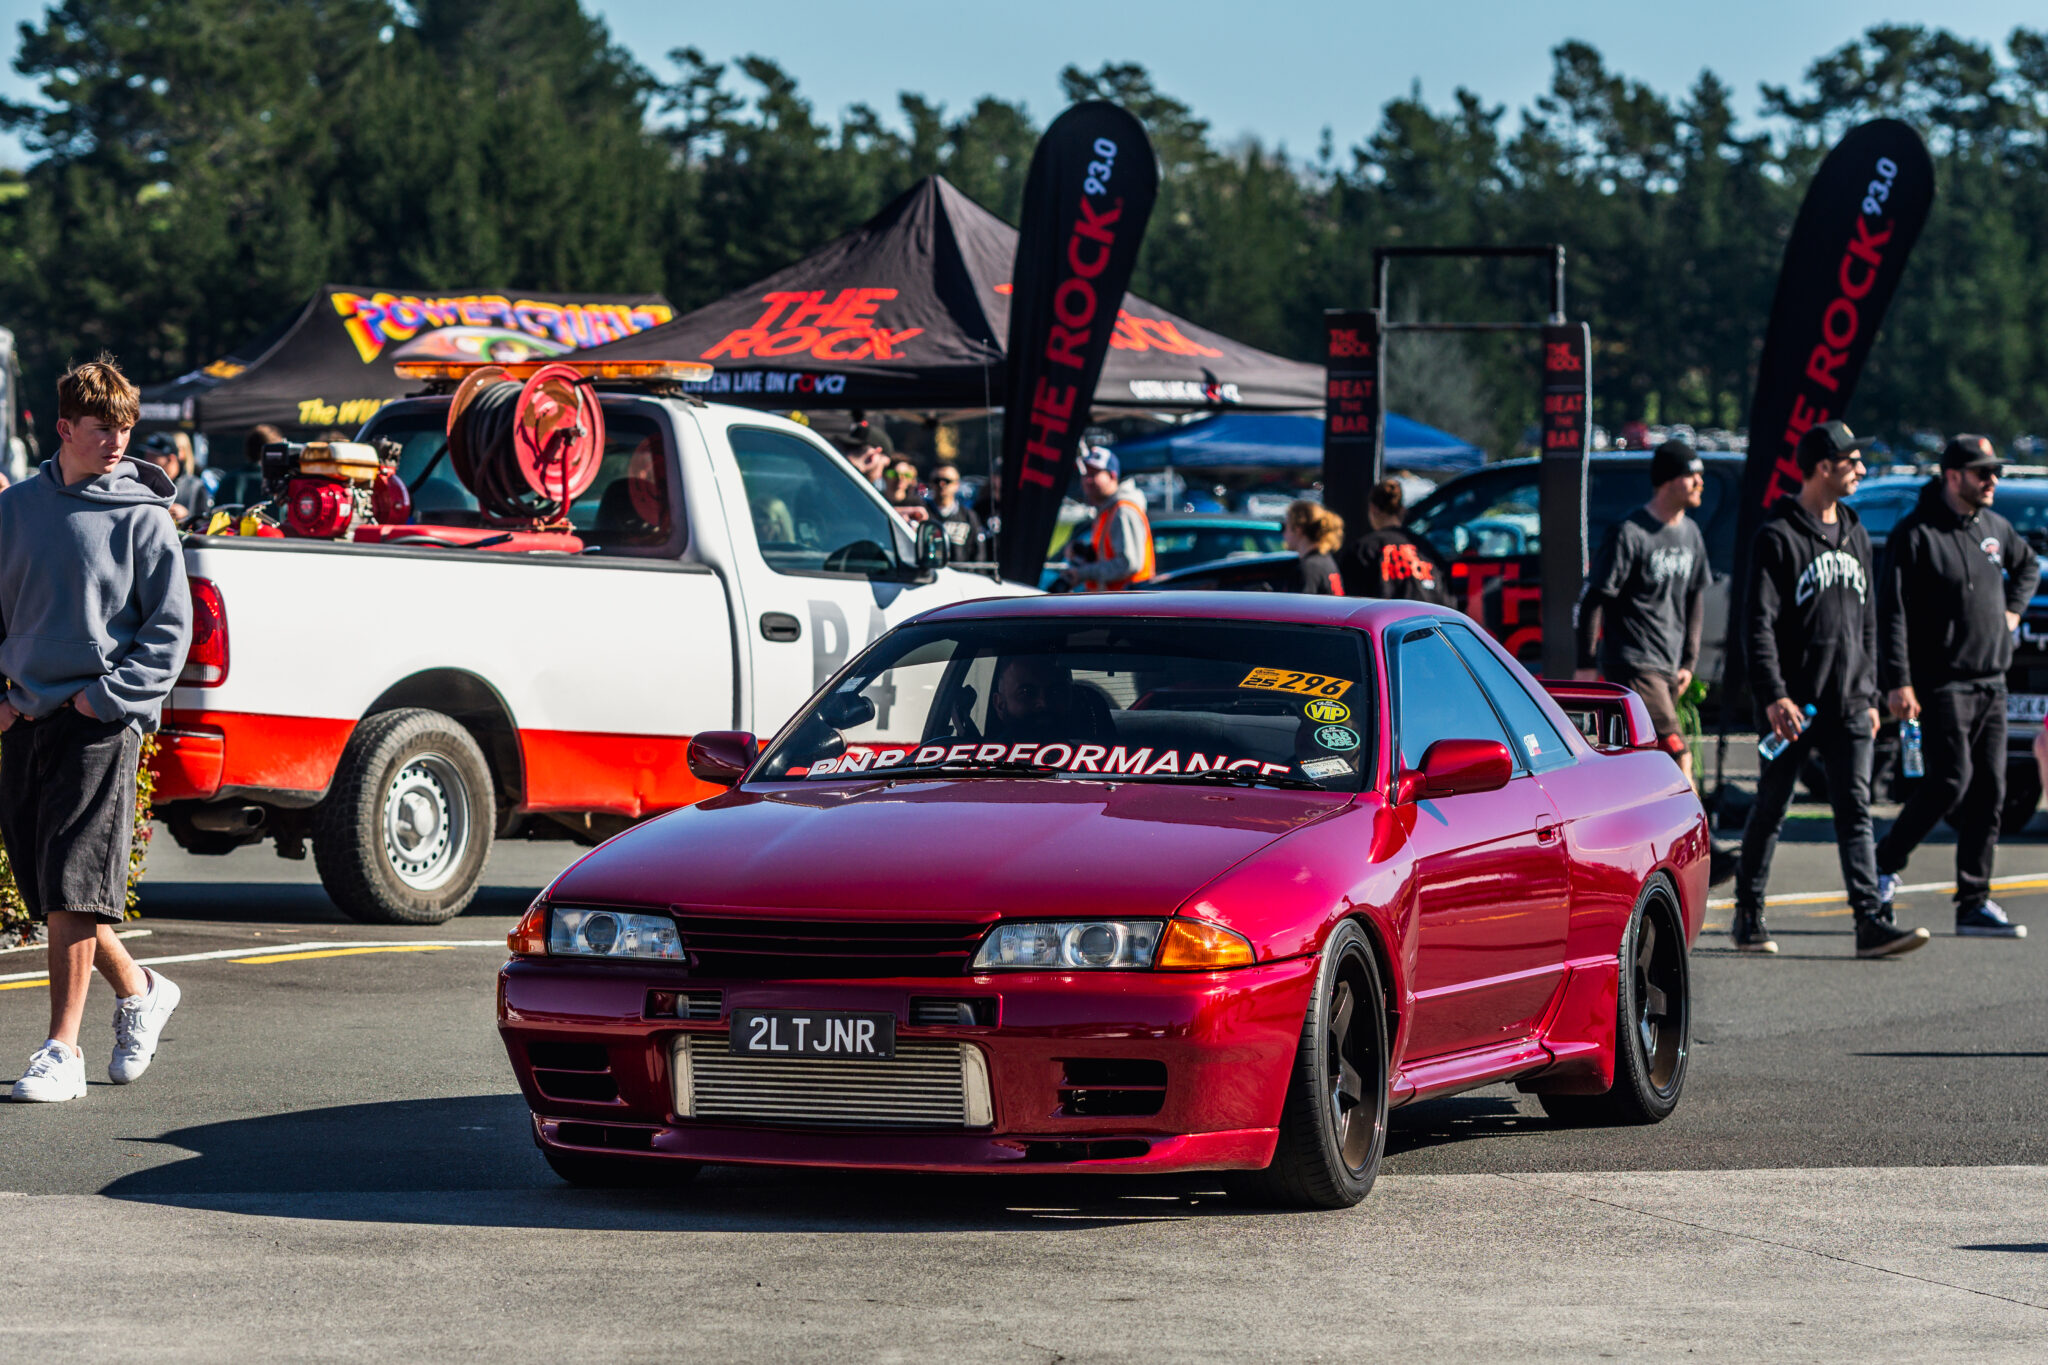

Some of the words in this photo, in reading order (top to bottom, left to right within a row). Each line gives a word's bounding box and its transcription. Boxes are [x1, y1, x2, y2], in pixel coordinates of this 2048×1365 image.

[1862, 157, 1898, 215] 93.0
[752, 288, 898, 330] THE
[1018, 376, 1077, 489] THE
[1083, 137, 1118, 196] 93.0
[733, 371, 762, 393] LIVE
[765, 371, 787, 393] ON
[788, 373, 846, 394] rova
[1328, 380, 1373, 399] BEAT
[298, 398, 338, 425] The
[1331, 415, 1369, 432] BAR
[1278, 673, 1345, 696] 296
[1311, 704, 1345, 720] VIP
[749, 1017, 875, 1053] 2LTJNR
